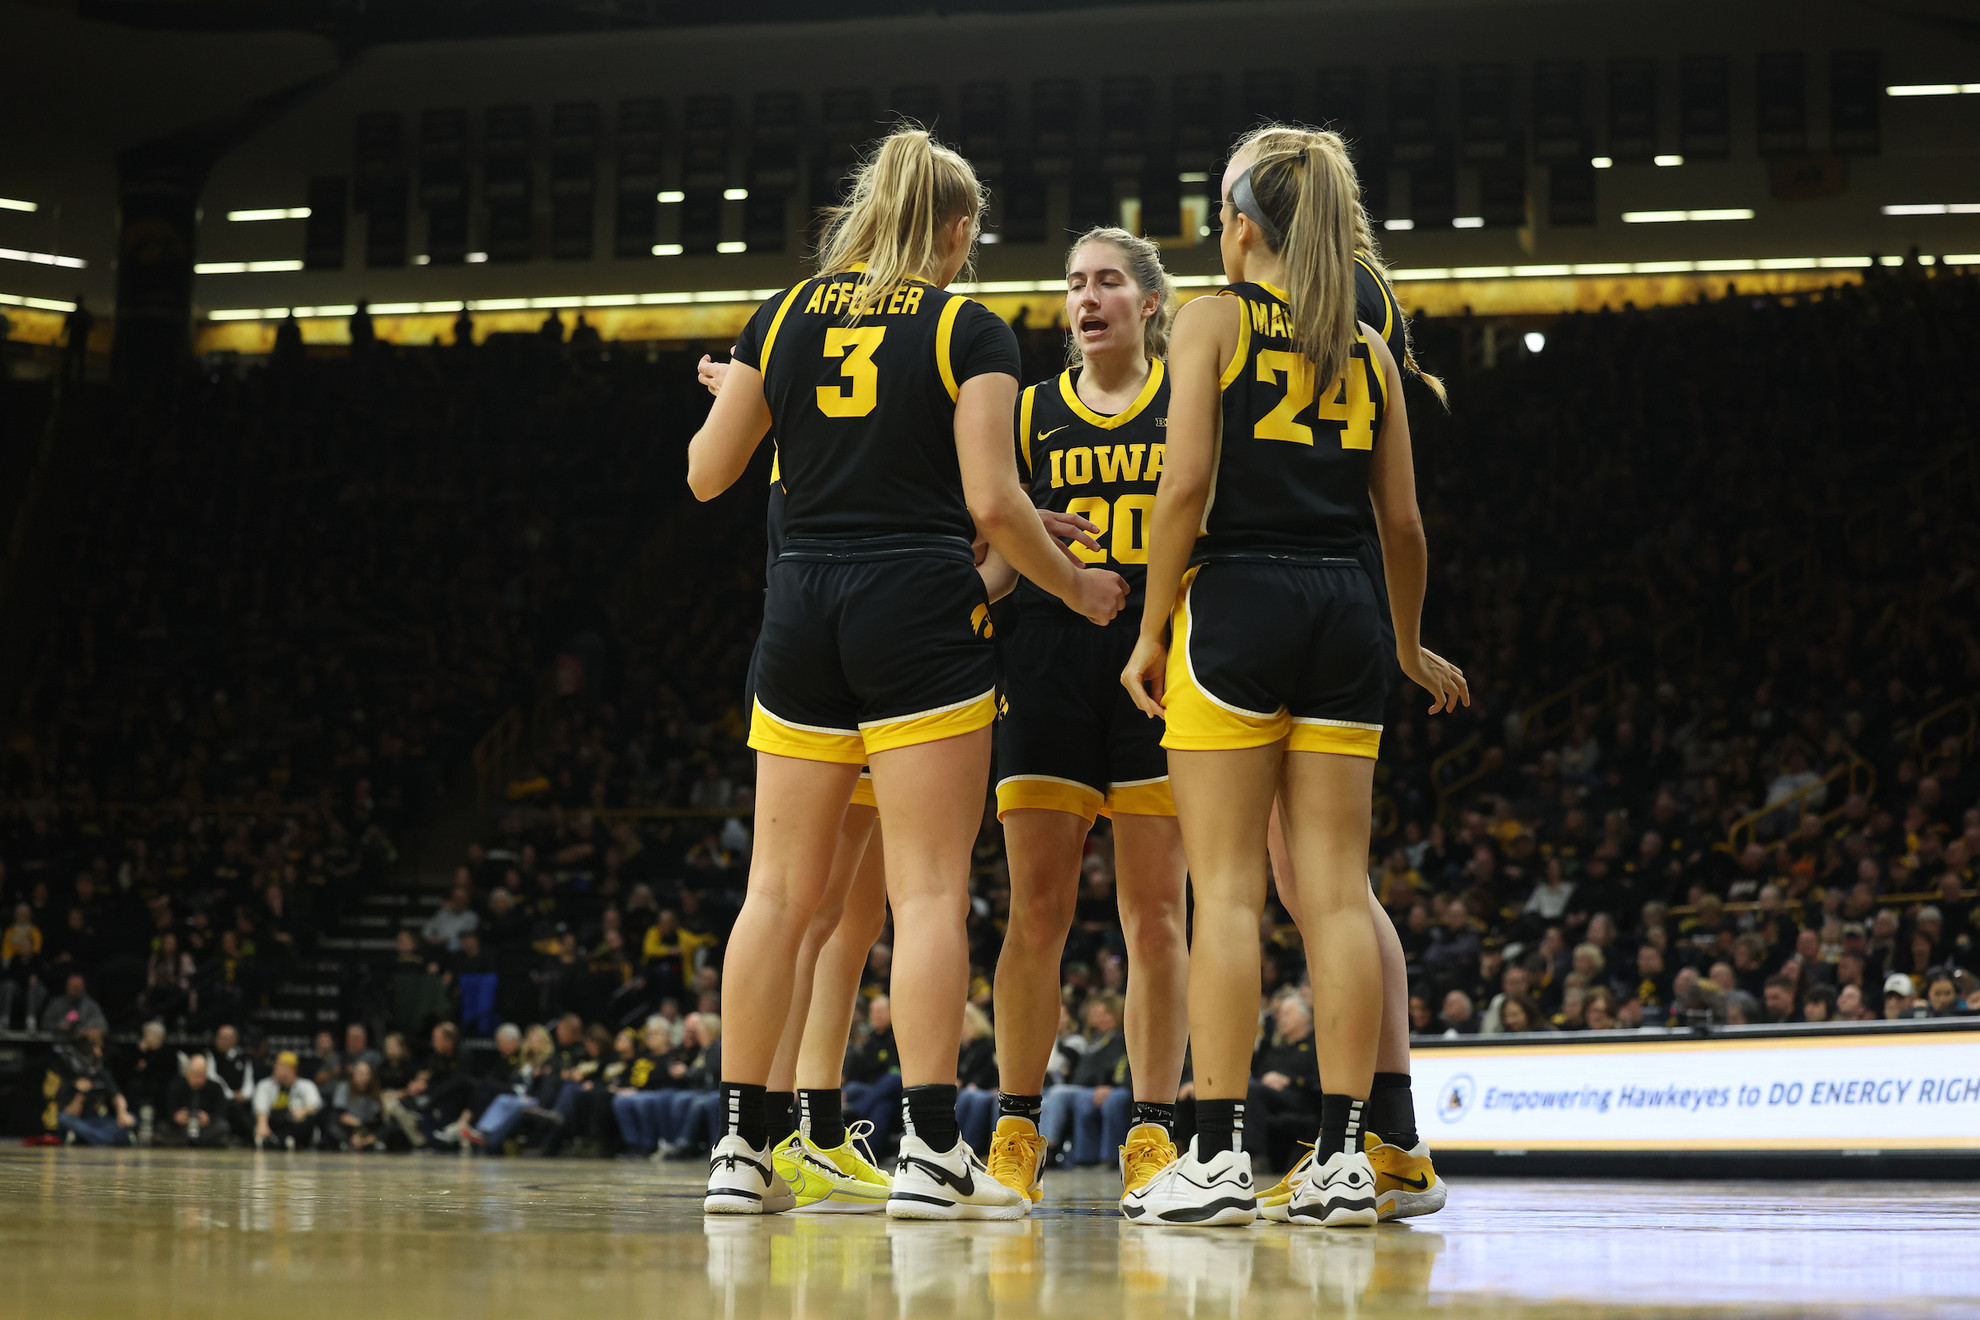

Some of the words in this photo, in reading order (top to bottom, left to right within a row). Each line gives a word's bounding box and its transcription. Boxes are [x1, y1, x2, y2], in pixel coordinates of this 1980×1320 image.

[815, 325, 887, 418] 3
[1253, 347, 1376, 451] 24
[1049, 442, 1167, 489] IOWA
[1065, 493, 1157, 565] 20
[1483, 1085, 1614, 1114] Empowering
[1617, 1082, 1731, 1113] Hawkeyes
[1737, 1082, 1762, 1108] to
[1767, 1080, 1804, 1107] DO
[1809, 1078, 1914, 1106] ENERGY
